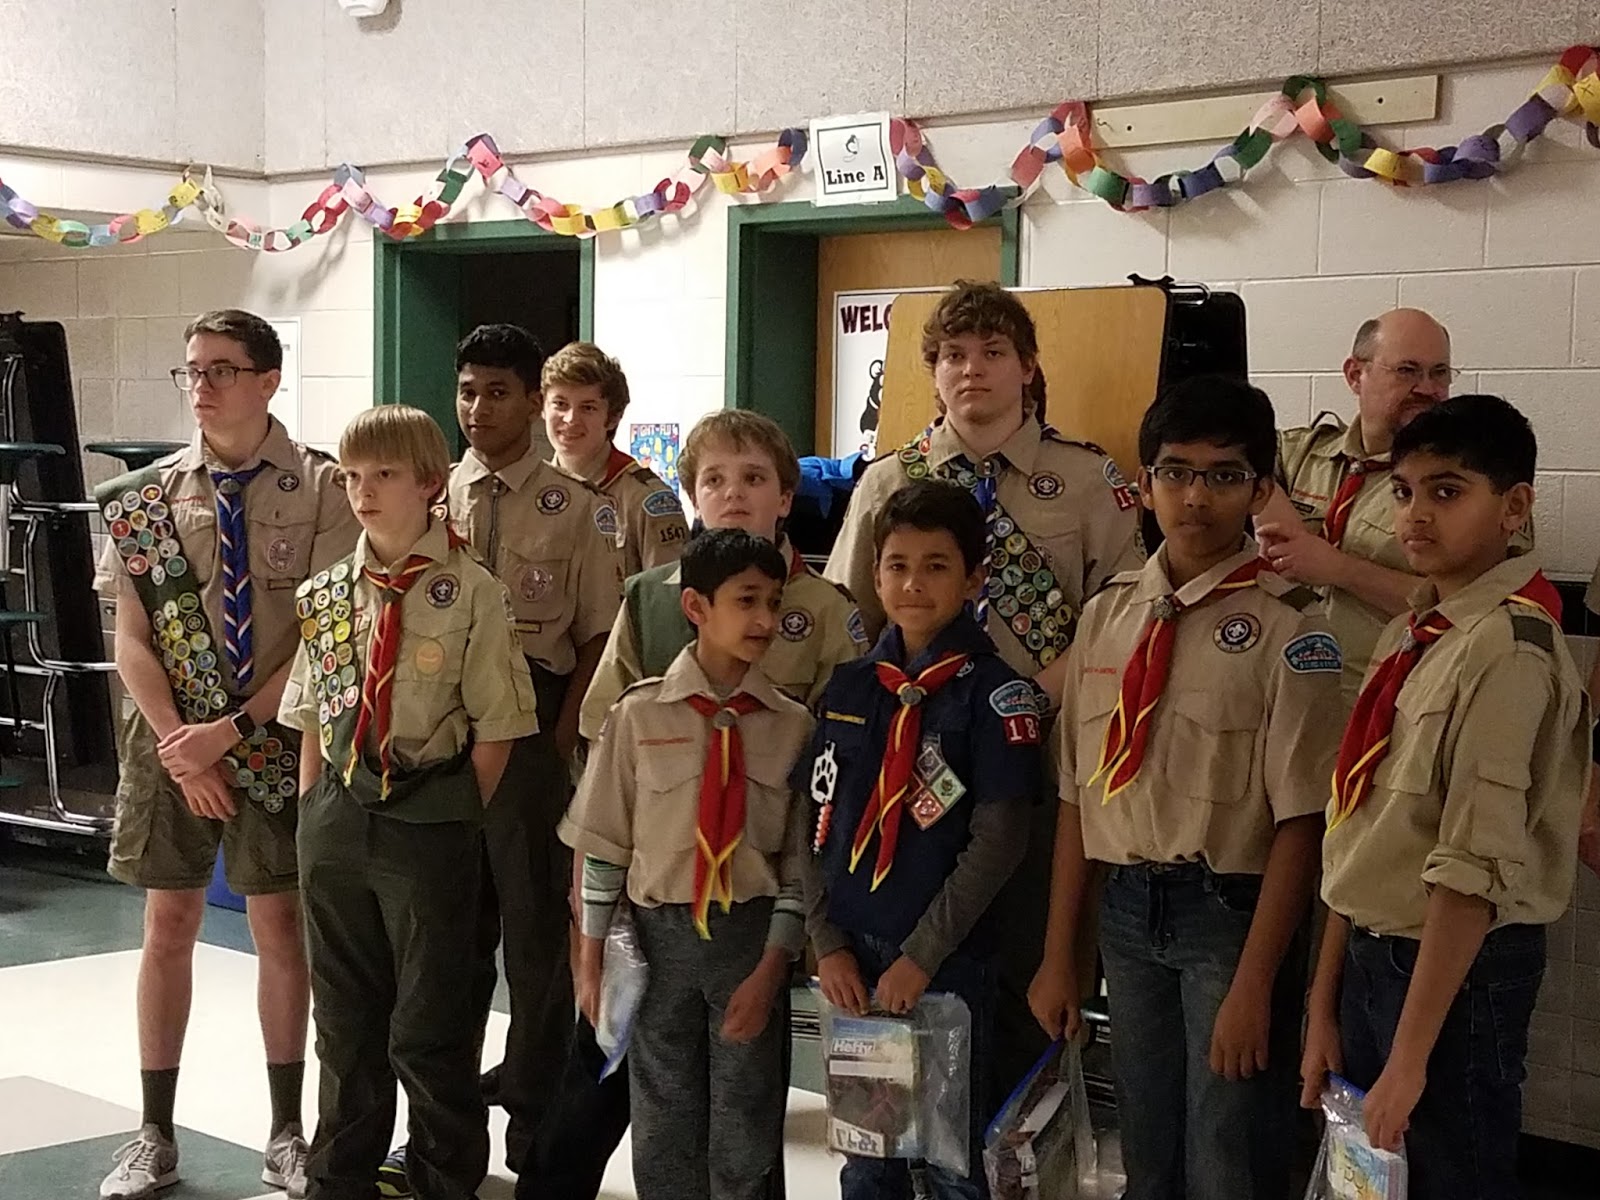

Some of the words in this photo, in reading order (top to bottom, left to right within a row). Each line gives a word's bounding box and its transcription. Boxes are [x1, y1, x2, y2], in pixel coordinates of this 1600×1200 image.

[826, 169, 865, 185] Line
[873, 165, 884, 180] A
[833, 1039, 873, 1056] Hefty
